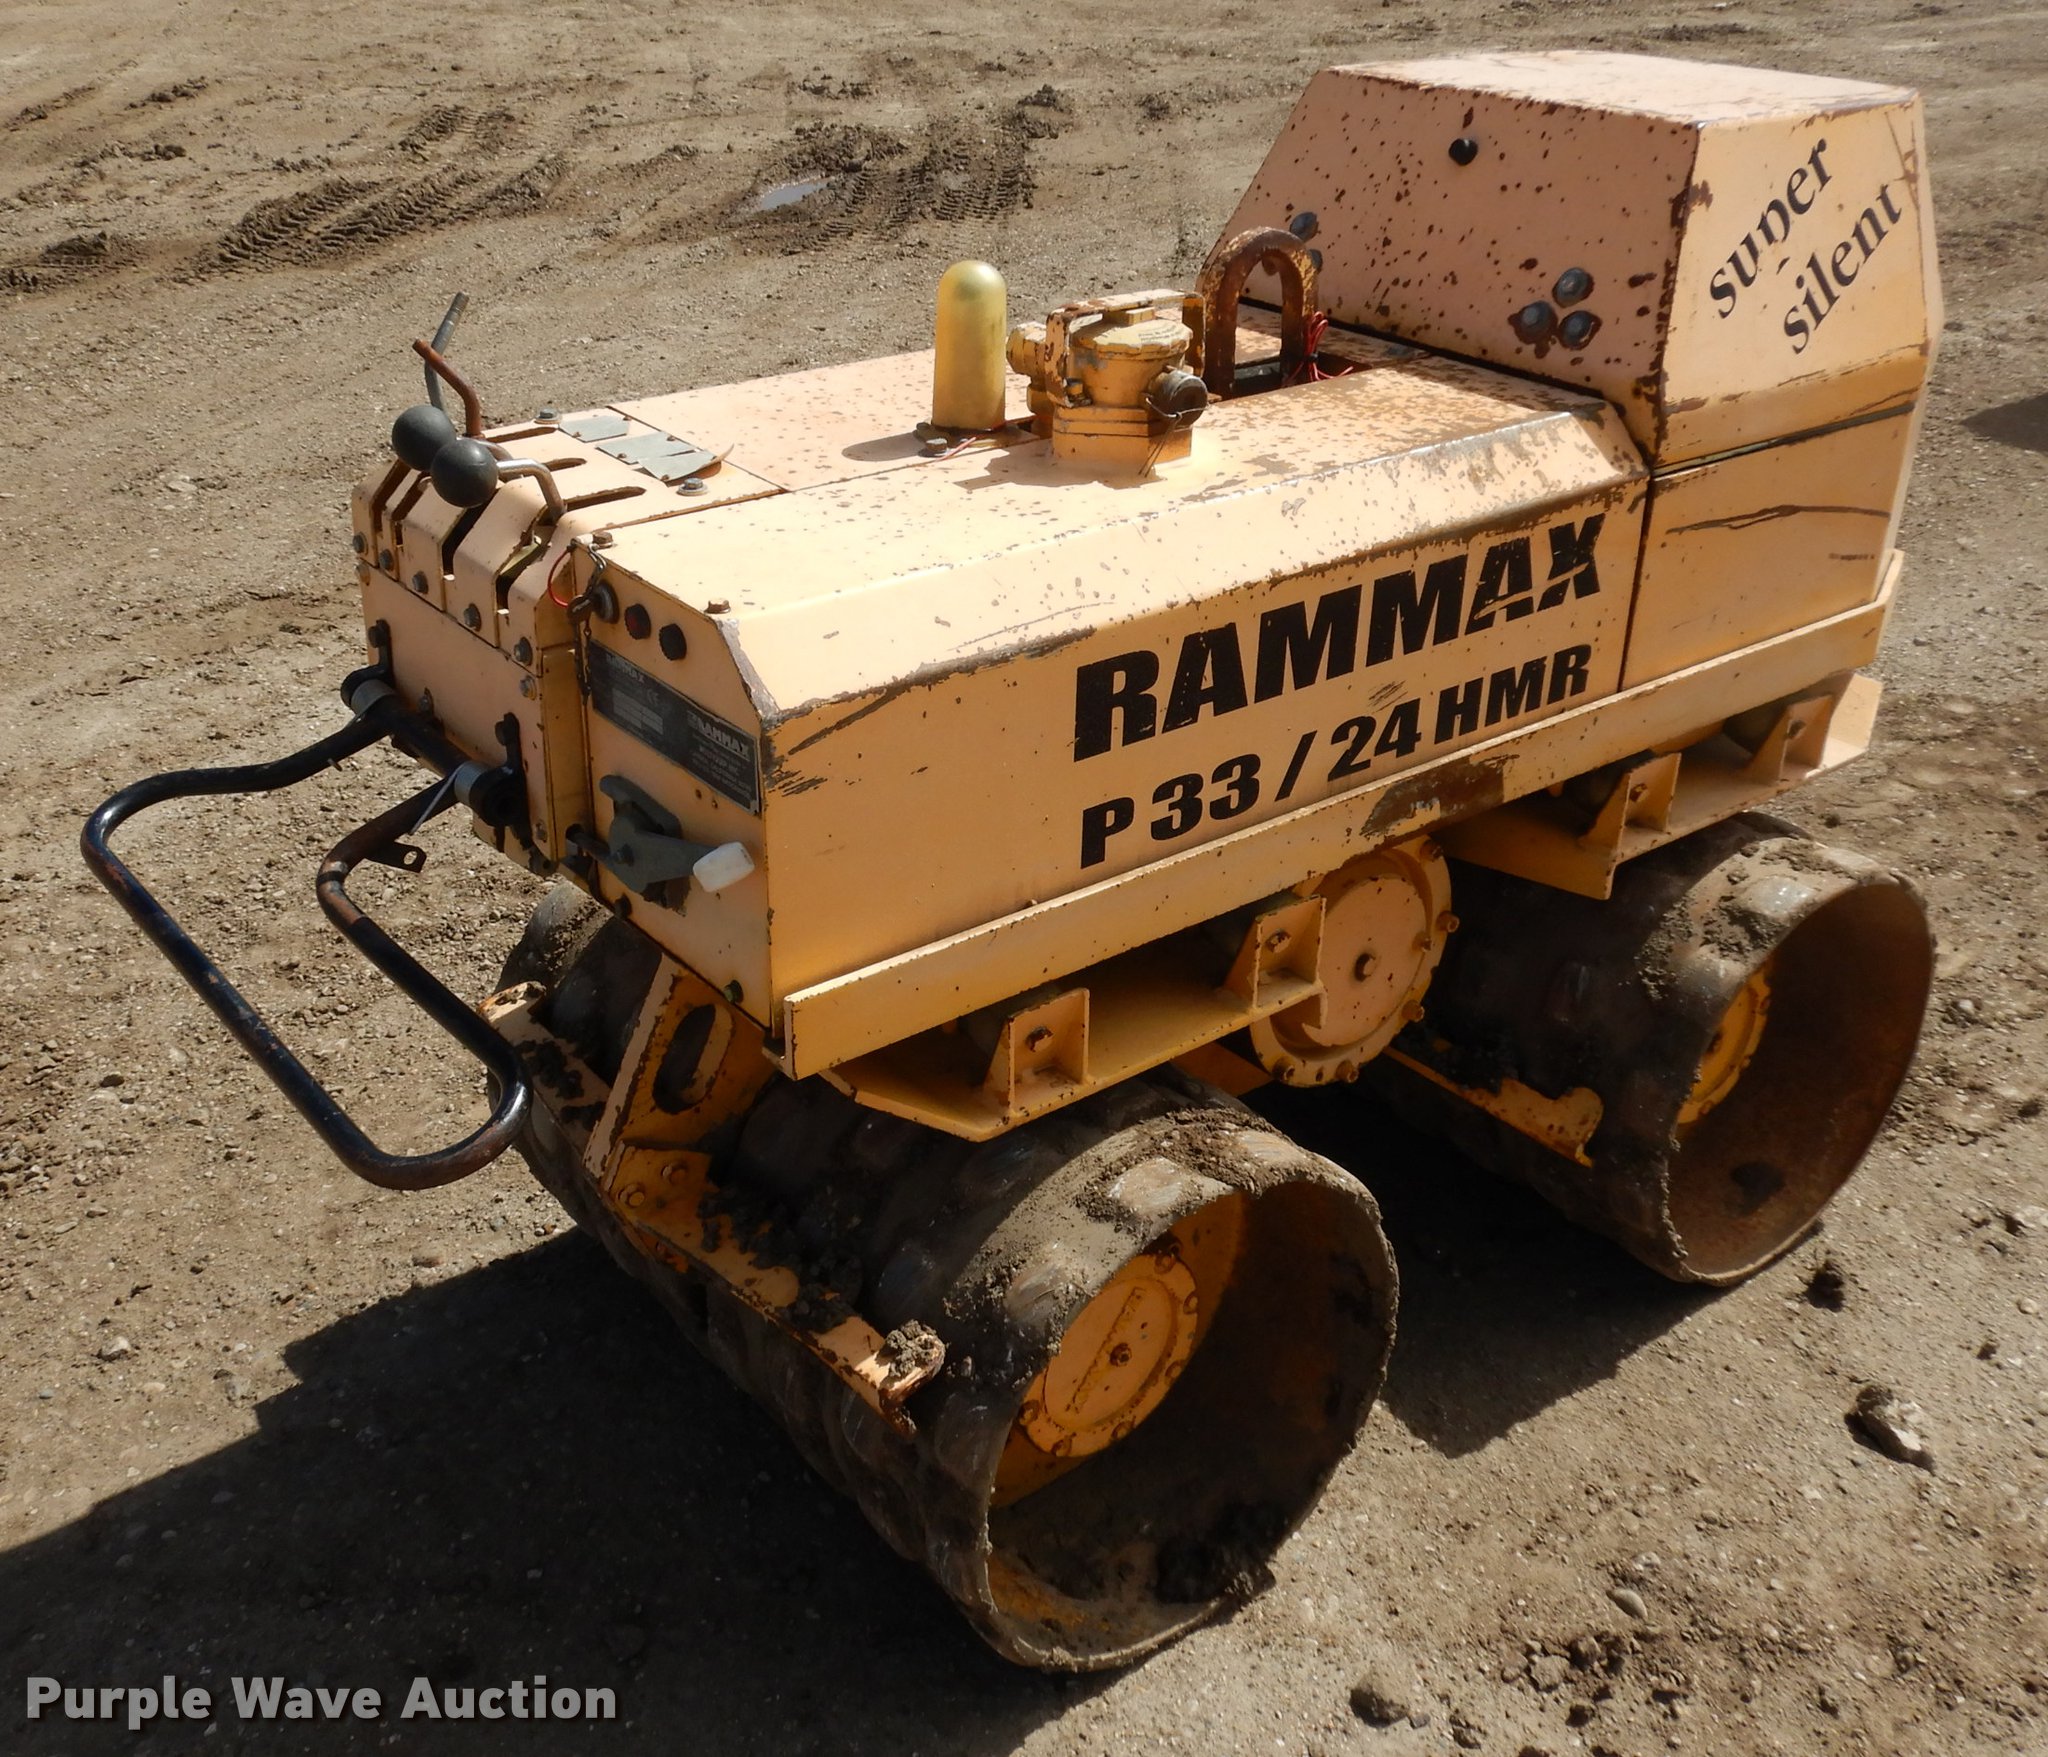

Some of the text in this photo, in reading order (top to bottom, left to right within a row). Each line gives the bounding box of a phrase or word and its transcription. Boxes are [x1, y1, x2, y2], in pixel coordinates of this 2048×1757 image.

[1710, 138, 1832, 319] super
[1784, 184, 1903, 354] silent
[1073, 513, 1606, 762] RAMMAX
[1081, 796, 1135, 869] P
[1150, 753, 1261, 840] 33
[1327, 698, 1423, 782] 24
[1434, 644, 1593, 744] HMR
